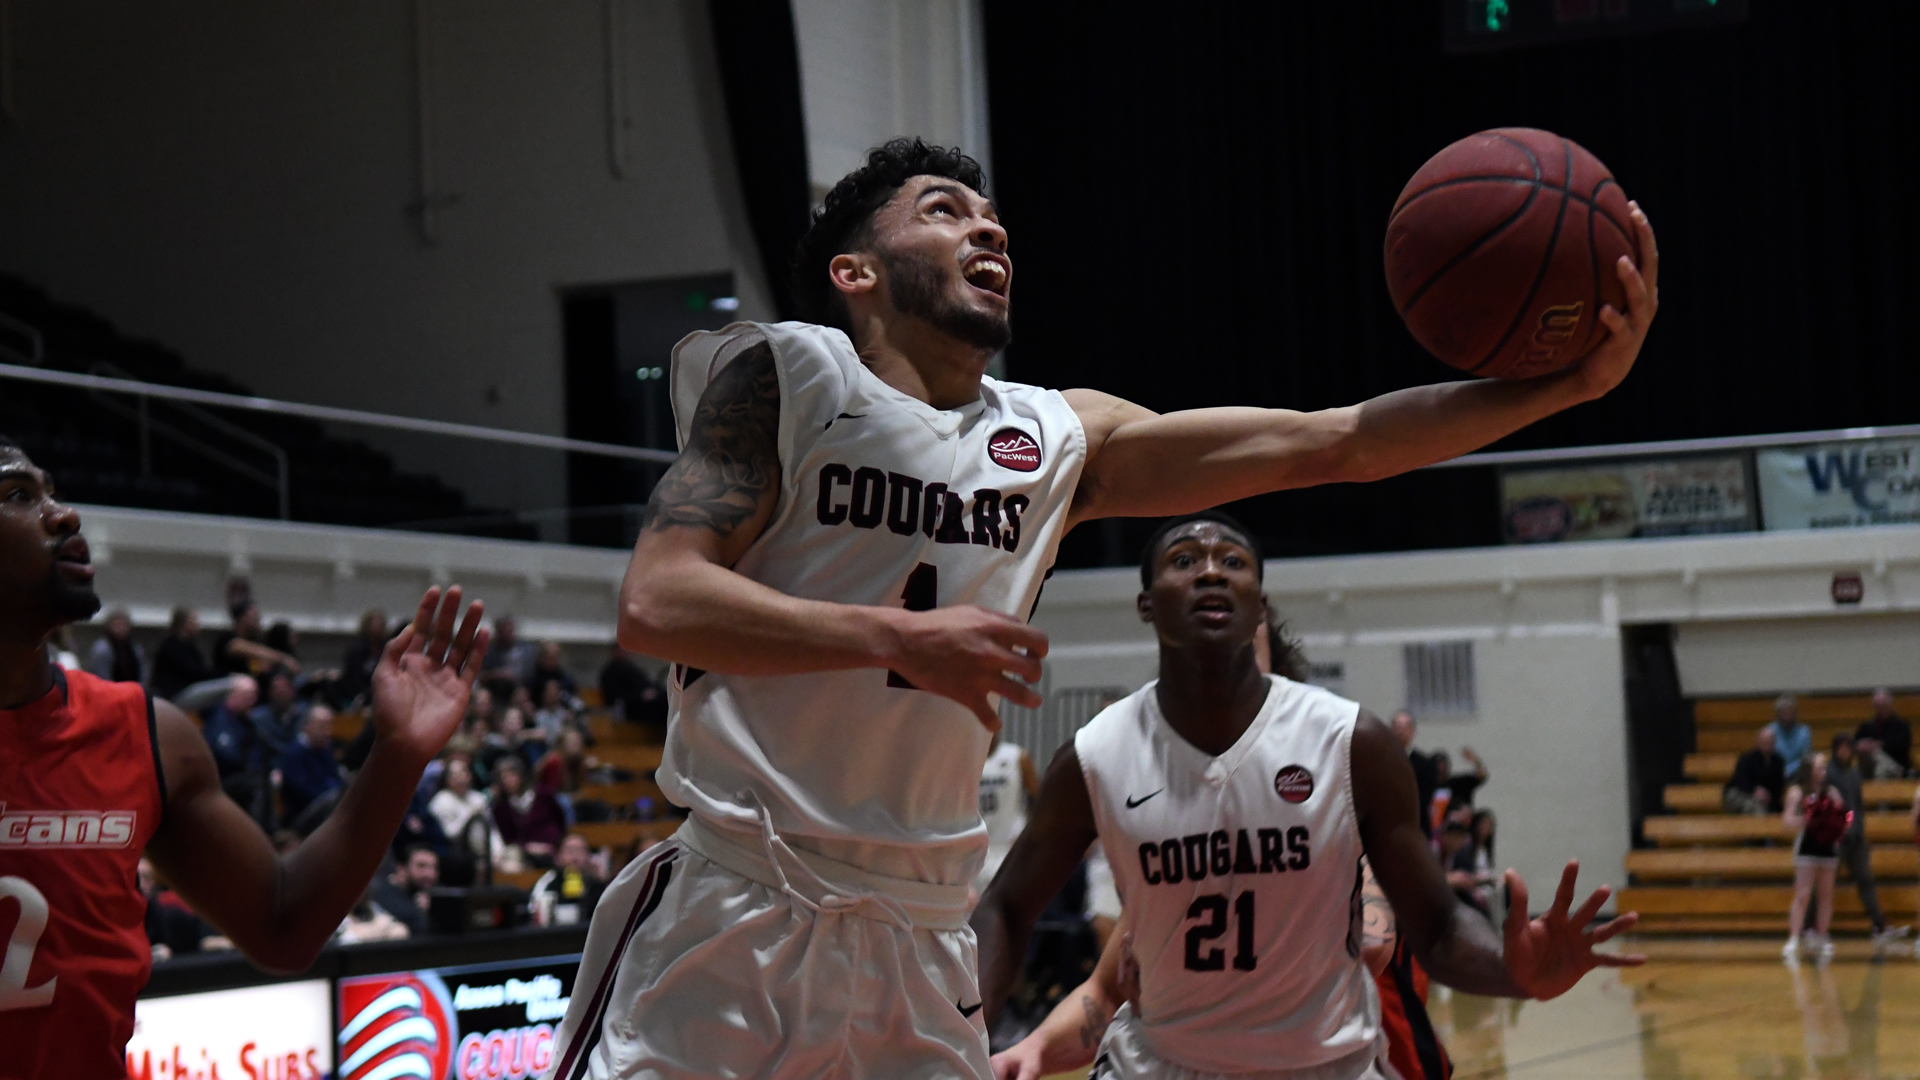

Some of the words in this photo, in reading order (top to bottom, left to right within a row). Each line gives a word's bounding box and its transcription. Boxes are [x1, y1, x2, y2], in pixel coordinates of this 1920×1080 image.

[993, 451, 1038, 463] PacWest
[817, 463, 1030, 553] COUGARS
[0, 809, 137, 849] cans
[1138, 826, 1310, 885] COUGARS
[1184, 890, 1257, 972] 21
[457, 1023, 564, 1080] COUG
